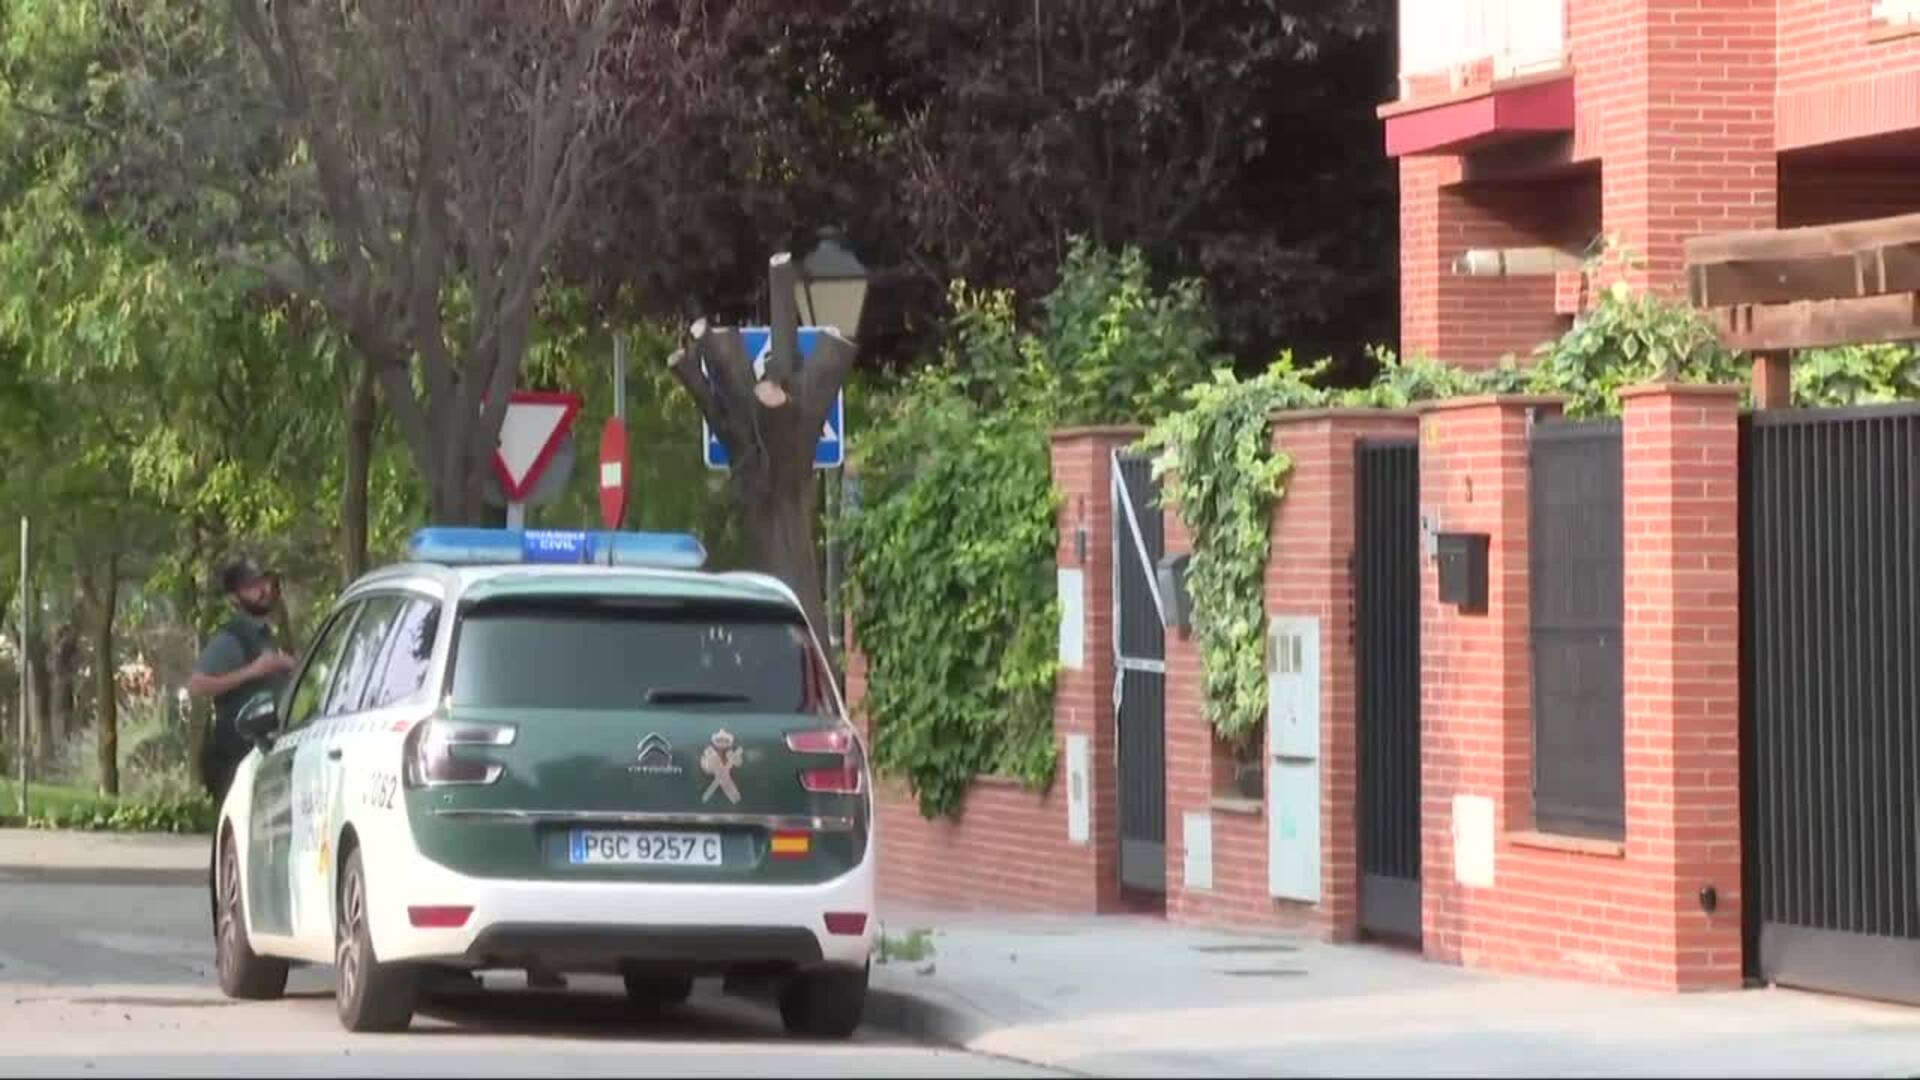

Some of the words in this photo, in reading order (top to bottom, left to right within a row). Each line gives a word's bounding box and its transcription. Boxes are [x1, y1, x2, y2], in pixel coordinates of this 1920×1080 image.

[539, 539, 577, 551] CIVIL
[584, 835, 629, 860] PGC
[637, 836, 696, 861] 9257
[703, 839, 717, 861] C
